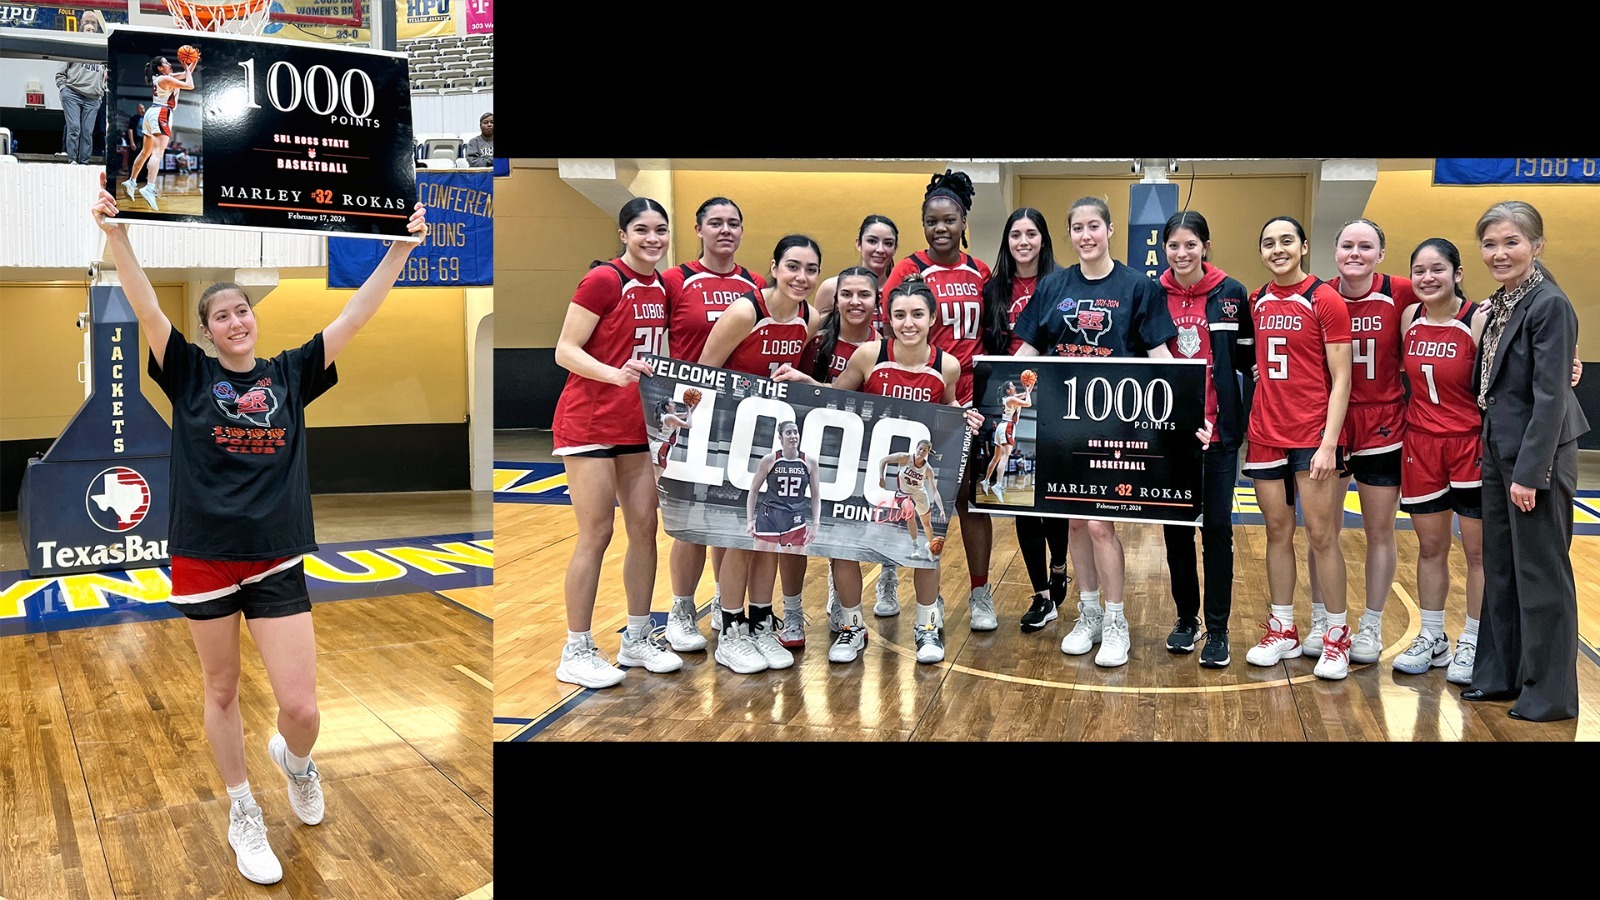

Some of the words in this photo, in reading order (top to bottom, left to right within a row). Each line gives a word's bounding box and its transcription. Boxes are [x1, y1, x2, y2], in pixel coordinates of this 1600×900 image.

[0, 6, 37, 21] HPU
[297, 6, 338, 15] WOMEN'S
[407, 0, 450, 16] HPU
[238, 57, 375, 119] 1000
[27, 93, 45, 105] EXIT
[331, 114, 380, 128] POINTS
[274, 134, 292, 145] SUL
[294, 135, 319, 146] ROSS
[322, 137, 349, 149] STATE
[277, 158, 348, 174] BASKETBALL
[1515, 158, 1600, 177] 1968-6
[221, 185, 302, 202] MARLEY
[311, 189, 333, 204] #32
[342, 194, 406, 210] ROKAS
[288, 212, 318, 222] February
[320, 214, 329, 223] 17,
[330, 214, 346, 223] 2024
[703, 291, 745, 305] LOBO
[936, 283, 979, 298] LOBOS
[941, 301, 981, 340] 40
[1258, 315, 1303, 331] LOBOS
[761, 339, 803, 355] LOBOS
[1407, 340, 1458, 359] LOBOS
[1267, 336, 1289, 380] 5
[641, 356, 728, 388] WELCOME
[756, 378, 789, 398] THE
[1420, 364, 1440, 405] 1
[111, 327, 125, 453] JACKETS
[881, 382, 932, 402] LOBOS
[1062, 376, 1174, 423] 1000
[1134, 420, 1176, 430] POINTS
[215, 436, 286, 447] POINTS
[660, 381, 932, 510] 1000
[962, 425, 973, 452] ROKAS
[1088, 440, 1102, 448] SUL
[1103, 440, 1124, 449] ROSS
[1126, 441, 1149, 450] STATE
[226, 445, 276, 455] CLUB
[774, 466, 788, 474] SUL
[788, 467, 805, 475] ROSS
[957, 452, 969, 484] MARLEY
[1089, 459, 1146, 471] BASKETBALL
[777, 476, 802, 497] 32
[1047, 482, 1108, 496] MARLEY
[1115, 483, 1132, 497] #32
[1140, 487, 1192, 500] ROKAS
[832, 503, 884, 523] POINT
[873, 495, 915, 526] Club
[1096, 503, 1119, 511] February
